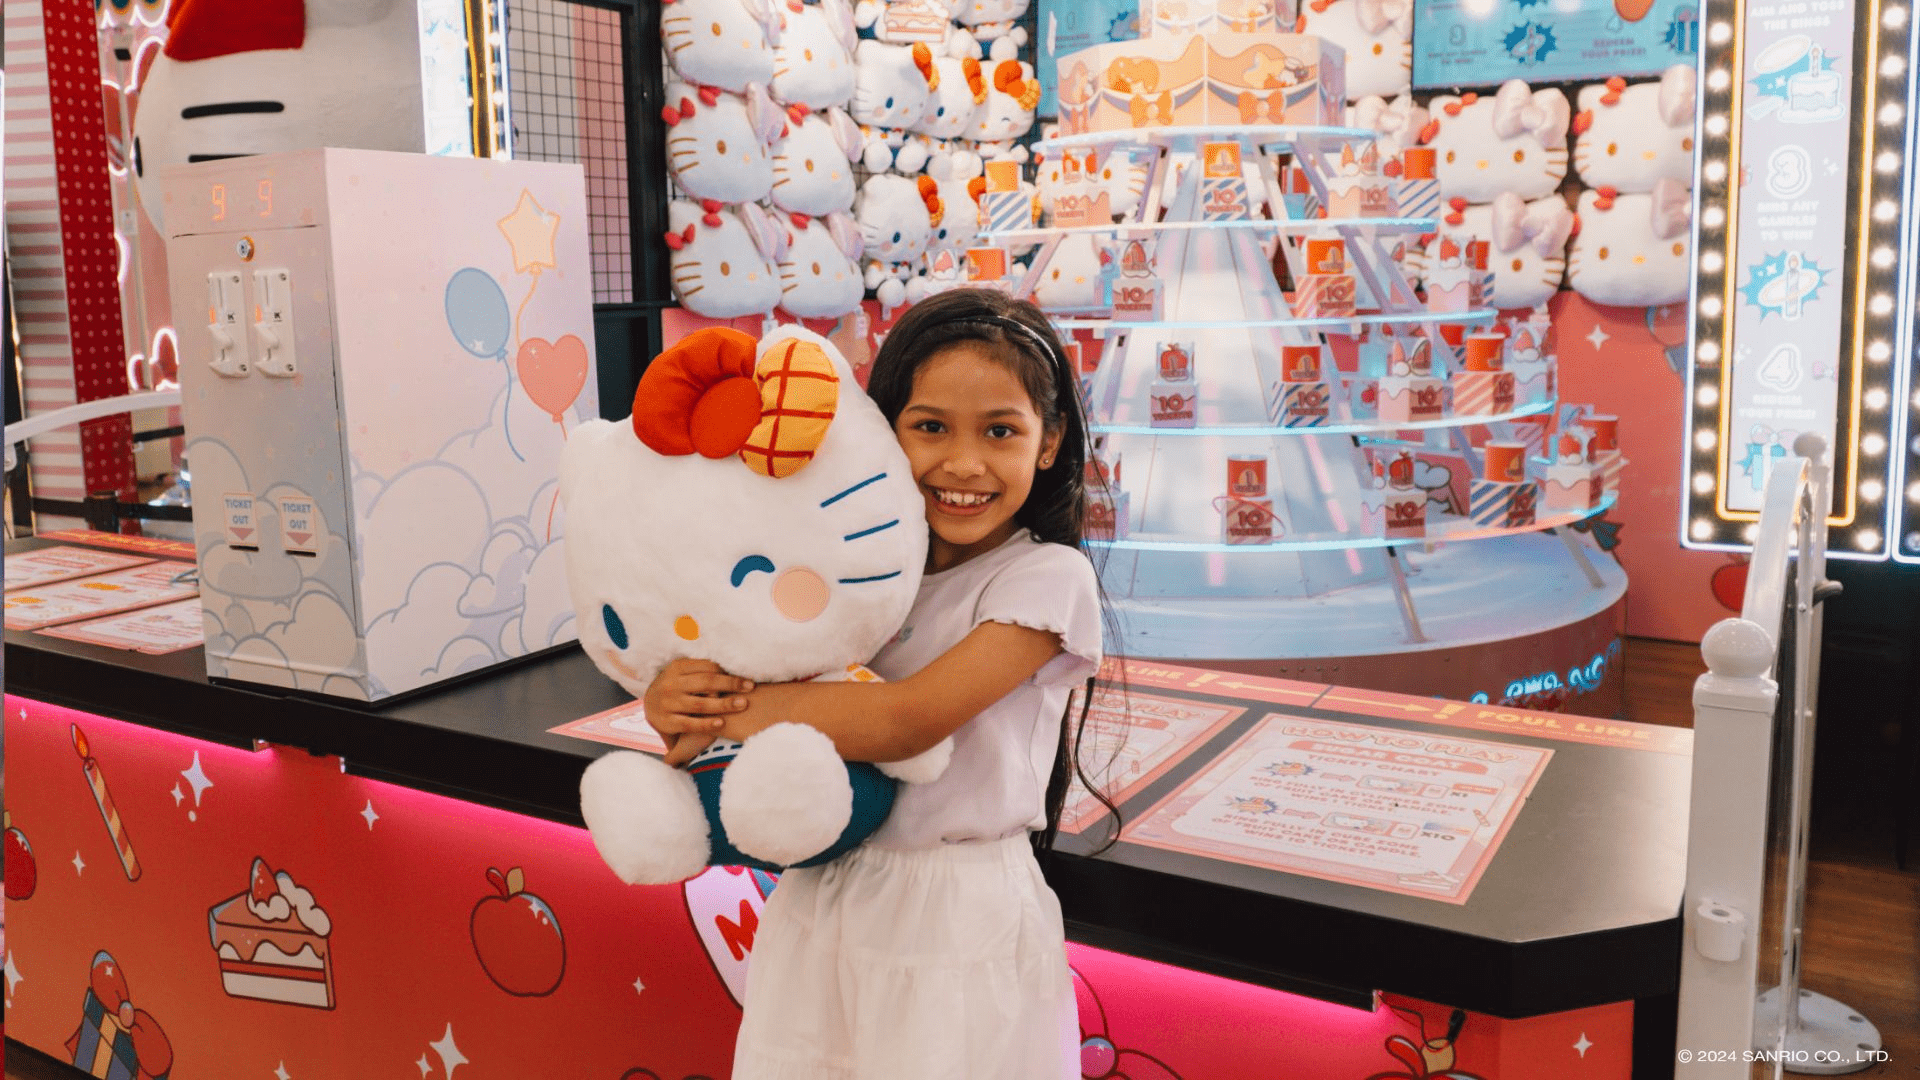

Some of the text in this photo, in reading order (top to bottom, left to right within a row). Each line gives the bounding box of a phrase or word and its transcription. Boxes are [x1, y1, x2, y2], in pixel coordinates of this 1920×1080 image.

[1778, 3, 1808, 15] AND
[1763, 19, 1787, 31] THE
[1768, 146, 1809, 197] 3
[212, 184, 225, 221] 9
[258, 178, 273, 218] 9
[1213, 188, 1236, 204] 10
[1122, 287, 1145, 302] 10
[1327, 286, 1349, 301] 10
[1759, 345, 1801, 390] 4
[1158, 393, 1184, 412] 10
[1297, 390, 1322, 407] 10
[225, 499, 252, 508] TICKET
[283, 503, 311, 513] TICKET
[1394, 501, 1418, 518] 10
[232, 515, 248, 524] OUT
[289, 520, 307, 529] OUT
[1238, 510, 1264, 527] 10
[1126, 666, 1184, 679] LINE
[1477, 711, 1562, 728] FOUL
[1575, 723, 1652, 740] LINE
[1282, 725, 1518, 763] HOW TO PLAY
[1311, 742, 1463, 769] SUGAR COAT
[1309, 754, 1440, 777] TICKET CHART
[1421, 831, 1455, 840] X10
